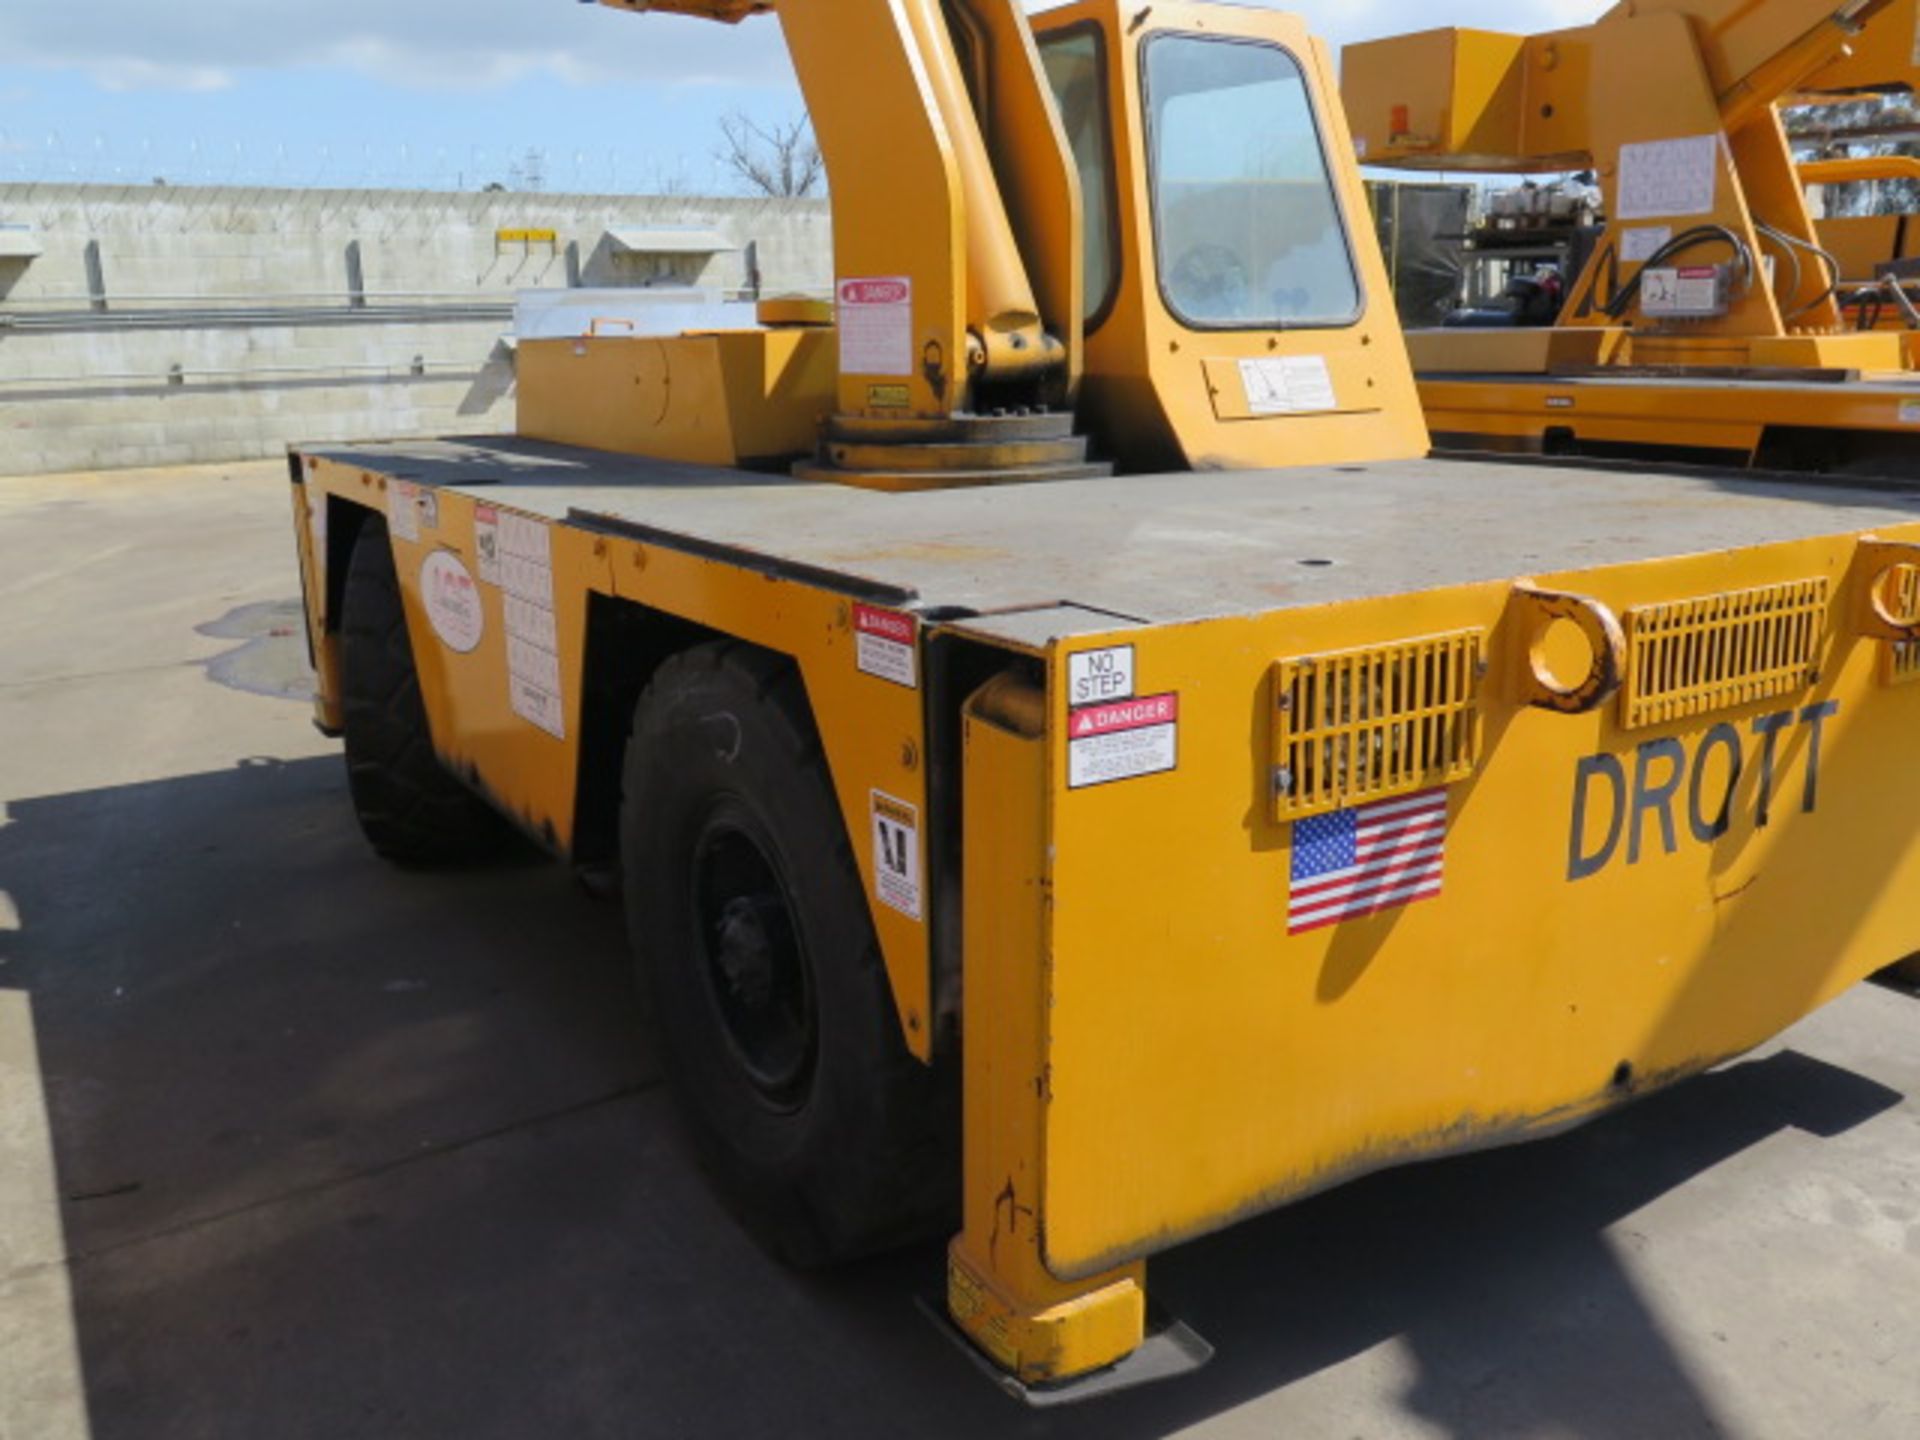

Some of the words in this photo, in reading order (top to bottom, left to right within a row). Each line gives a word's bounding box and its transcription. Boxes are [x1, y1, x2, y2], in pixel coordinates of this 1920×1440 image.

[1088, 653, 1114, 674] NO
[1076, 671, 1125, 699] STEP
[1097, 702, 1168, 727] DANGER
[1566, 699, 1840, 882] DROTT
